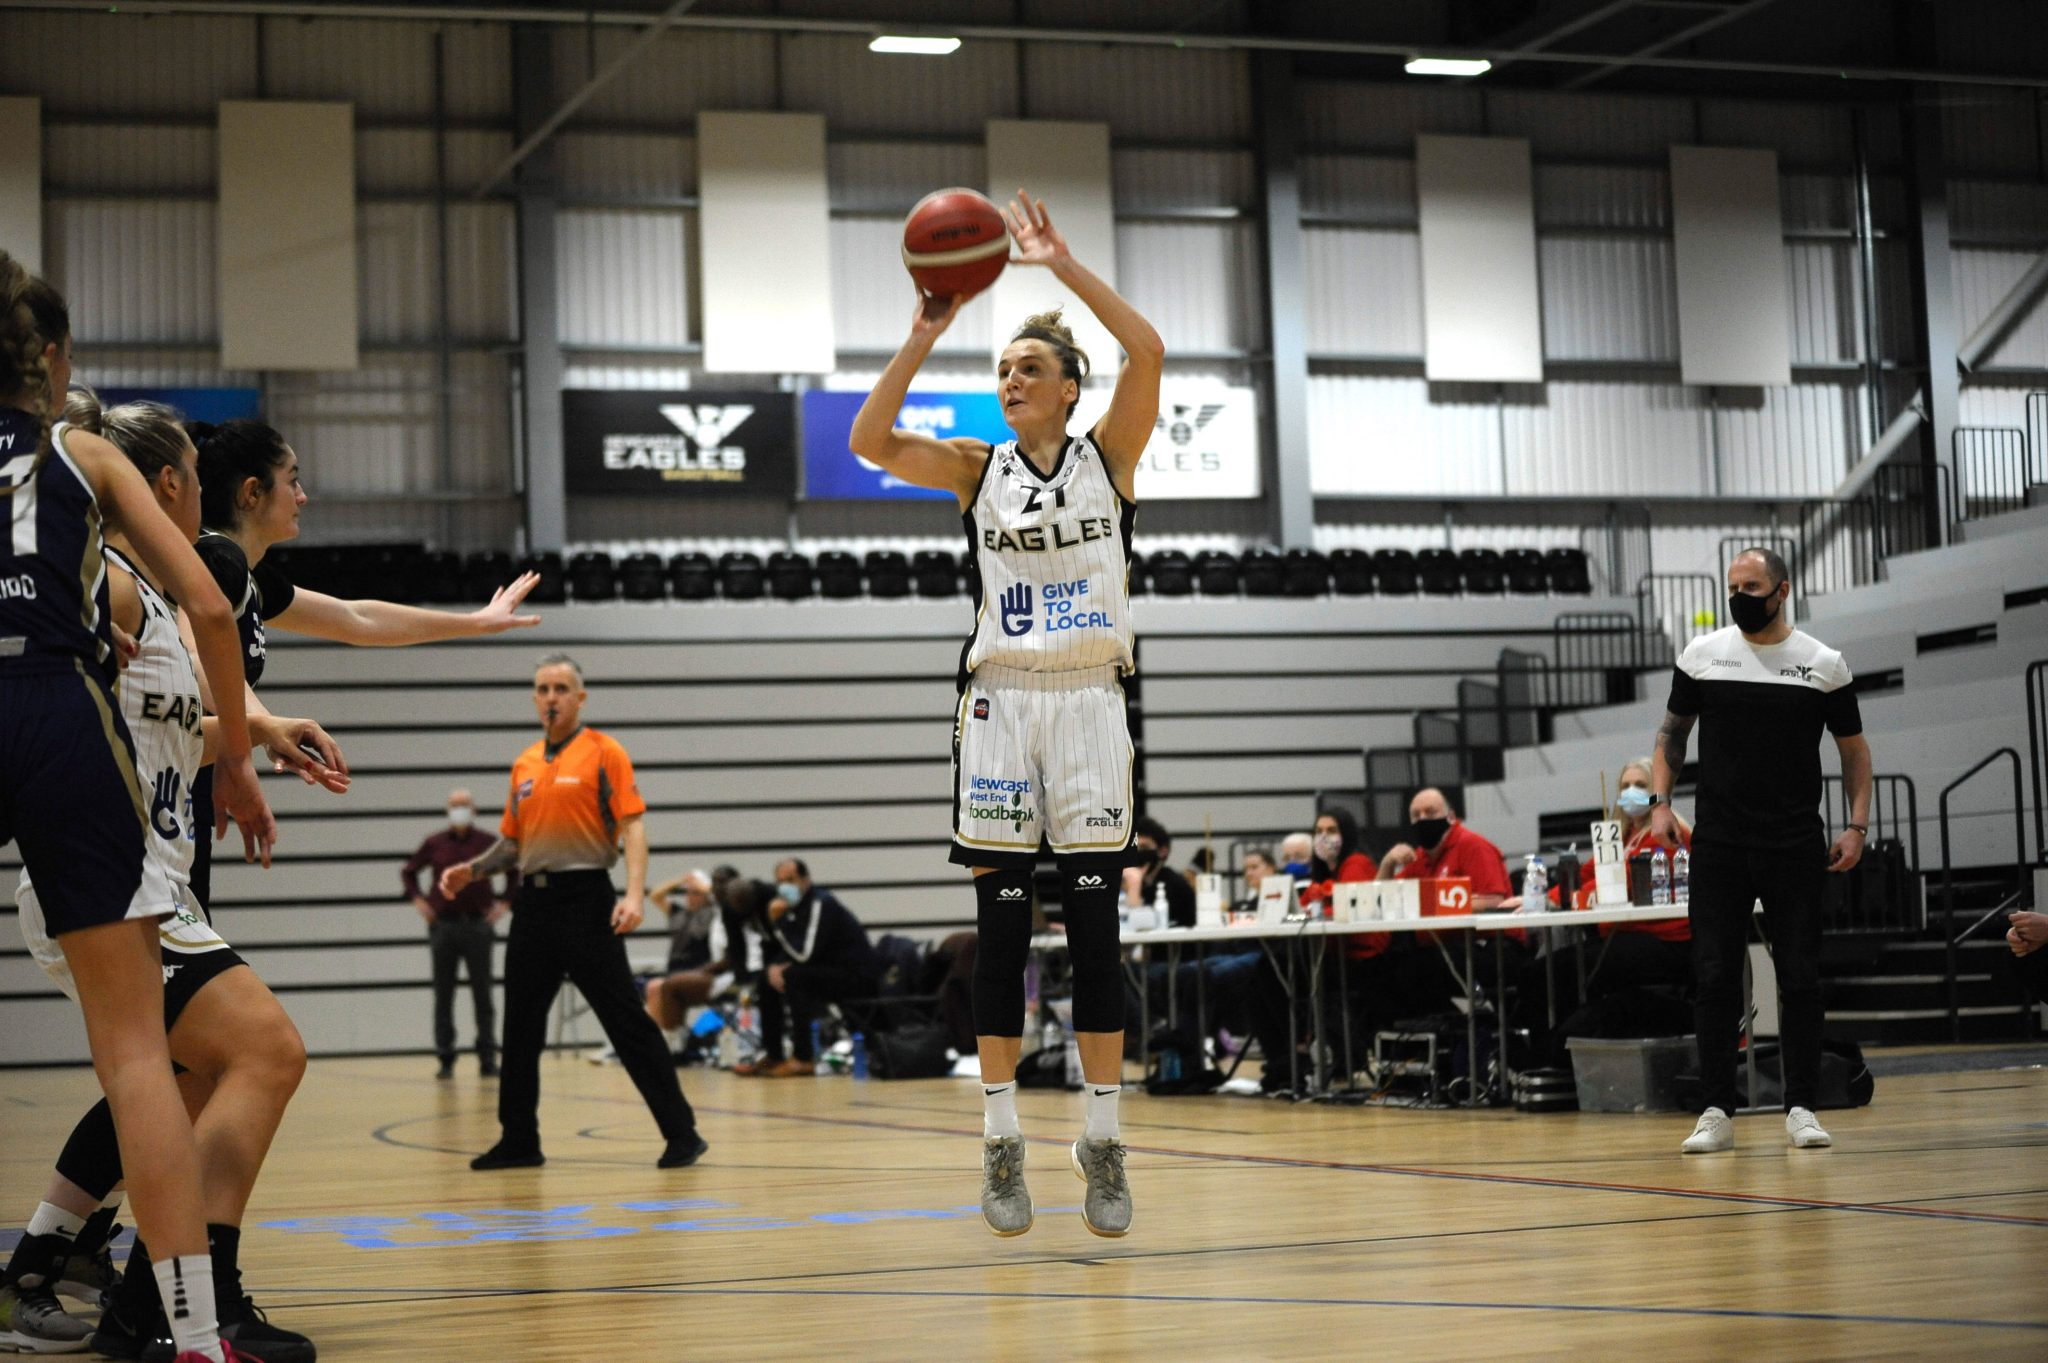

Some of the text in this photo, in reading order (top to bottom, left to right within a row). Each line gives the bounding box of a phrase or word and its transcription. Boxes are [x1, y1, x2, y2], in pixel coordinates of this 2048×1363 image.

[603, 447, 746, 471] EAGLES
[1135, 452, 1221, 472] LES
[1020, 481, 1068, 514] 21
[984, 517, 1113, 553] EAGLES
[1042, 579, 1089, 600] GIVE
[1044, 600, 1072, 616] TO
[1046, 612, 1113, 632] LOCAL
[990, 793, 1007, 803] End
[969, 803, 1034, 822] foodbank
[1439, 885, 1468, 909] 5
